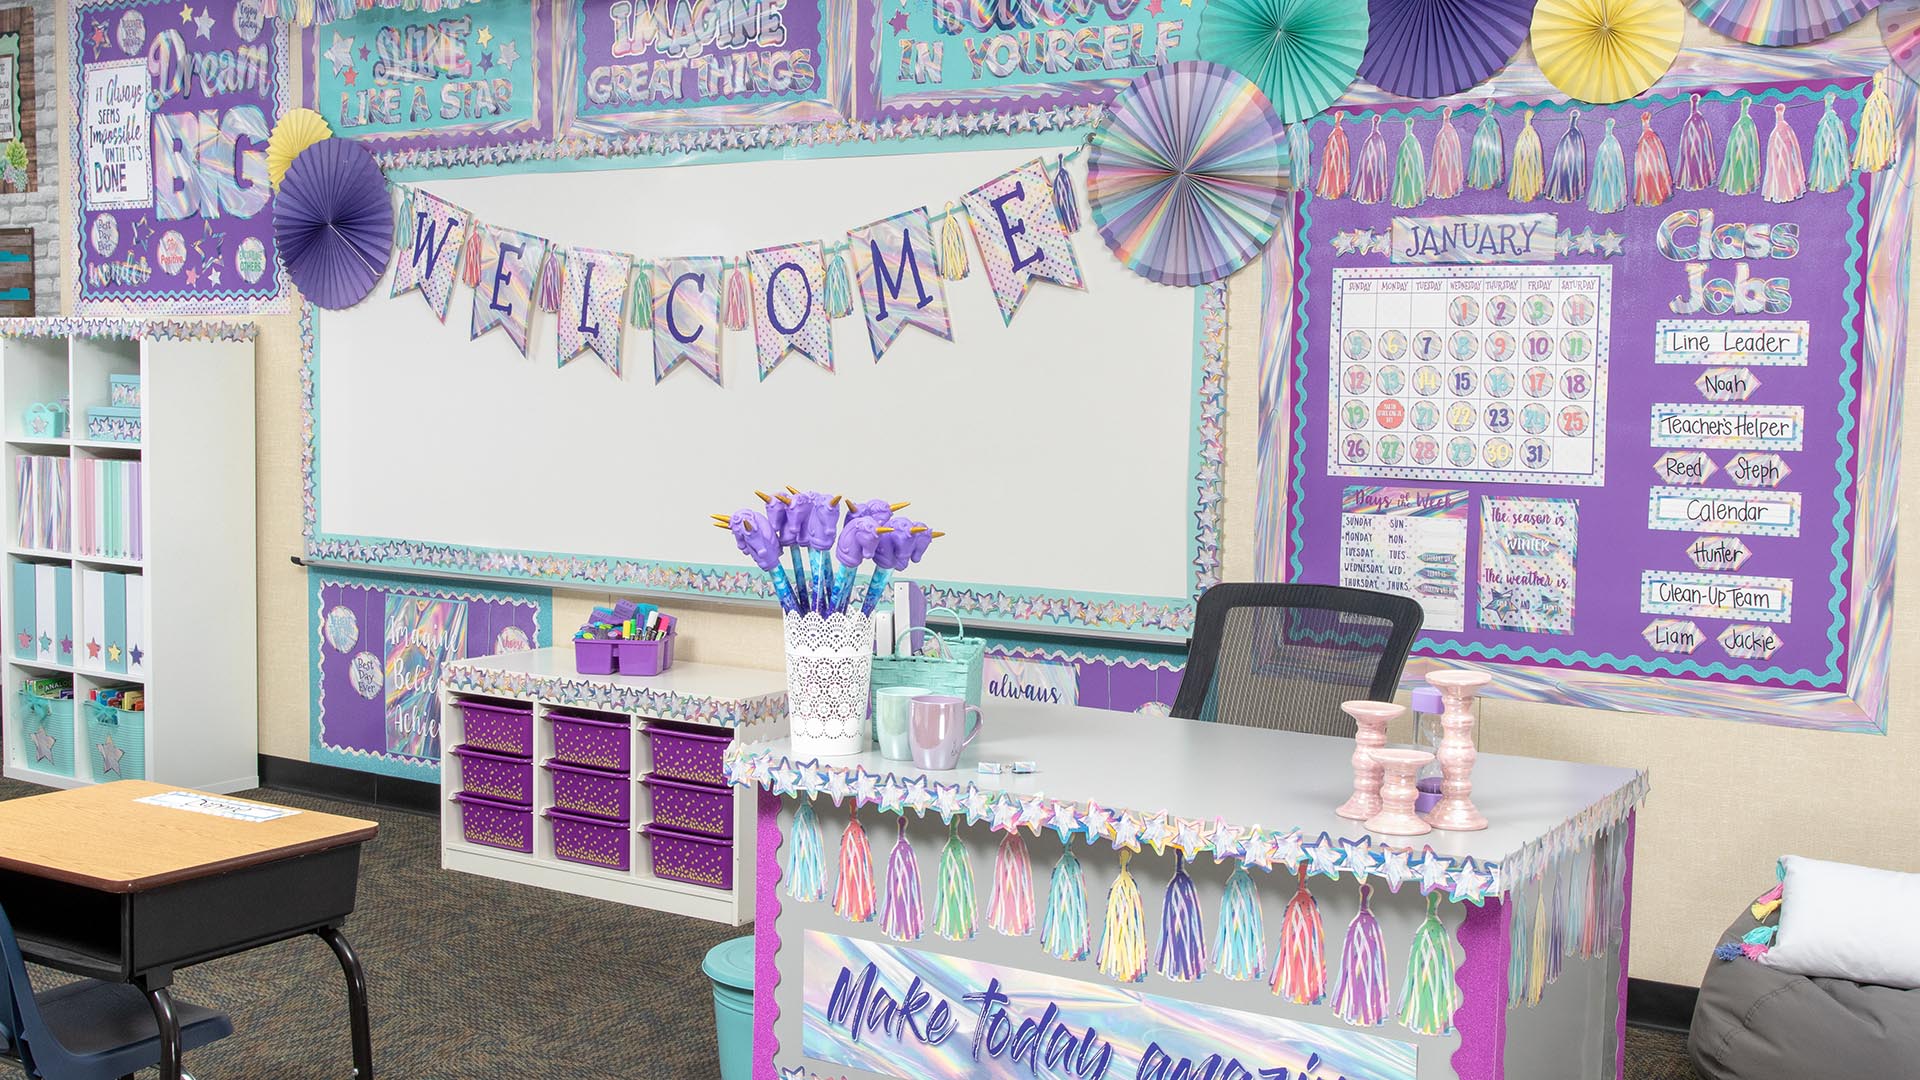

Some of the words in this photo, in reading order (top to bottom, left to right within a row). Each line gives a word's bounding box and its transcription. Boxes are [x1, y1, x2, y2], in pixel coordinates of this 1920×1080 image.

[610, 0, 787, 58] IMAGINE
[373, 14, 473, 86] SHINE
[896, 39, 944, 84] IN
[963, 19, 1185, 81] YOURSELF
[145, 29, 272, 112] Dream
[583, 57, 691, 105] GREAT
[690, 48, 814, 97] THINGS
[340, 88, 401, 127] LIKE
[409, 86, 432, 123] A
[440, 78, 513, 120] STAR
[98, 108, 120, 124] SEEMS
[89, 114, 142, 153] Impossible
[105, 146, 125, 163] UNTIL
[128, 146, 143, 161] IT'S
[154, 105, 272, 220] BIG
[94, 162, 128, 193] DONE
[1405, 221, 1541, 257] JANUARY
[1656, 208, 1800, 261] Class
[412, 181, 1045, 344] WELCOME
[1349, 282, 1372, 291] SUNDAY
[1381, 281, 1408, 291] MONDAY
[1416, 281, 1443, 291] TUESDAY
[1450, 280, 1482, 291] WEDNESDAY
[1486, 280, 1518, 290] THURSDAY
[1528, 280, 1552, 290] FRIDAY
[1561, 280, 1596, 290] SATURDAY
[1669, 263, 1792, 315] Jobs
[1461, 303, 1467, 320] 1
[1496, 301, 1506, 320] 2
[1532, 301, 1544, 319] 3
[1388, 335, 1398, 354] 6
[1422, 336, 1432, 354] 7
[1457, 336, 1469, 355] 8
[1495, 337, 1506, 355] 9
[1529, 337, 1549, 355] 10
[1570, 337, 1583, 356] 11
[1673, 332, 1710, 352] Line
[1724, 332, 1790, 352] Leader
[1350, 371, 1365, 390] 12
[1382, 371, 1399, 390] 13
[1419, 370, 1436, 390] 14
[1455, 372, 1471, 390] 15
[1529, 373, 1545, 392] 17
[1566, 374, 1586, 394] 18
[1705, 374, 1747, 394] Noah
[1347, 405, 1364, 424] 19
[1416, 406, 1433, 425] 21
[1452, 406, 1471, 425] 22
[1489, 408, 1509, 427] 23
[1562, 411, 1584, 431] 25
[1661, 415, 1732, 435] Teacher's
[1734, 415, 1789, 439] Helper
[1347, 440, 1365, 457] 26
[1381, 441, 1399, 459] 27
[1415, 441, 1435, 460] 28
[1487, 444, 1508, 463] 30
[1526, 445, 1542, 462] 31
[1666, 457, 1702, 477] Reed
[1735, 457, 1779, 483] Steph
[1355, 490, 1392, 512] Days
[1397, 499, 1412, 508] the
[1416, 491, 1455, 509] Week
[1687, 499, 1768, 522] Calendar
[1346, 517, 1372, 527] SUNDAY
[1390, 519, 1408, 529] SUN.
[1491, 507, 1509, 523] The
[1512, 512, 1552, 525] season
[1555, 512, 1566, 527] is
[1345, 531, 1373, 542] MONDAY
[1388, 534, 1407, 544] MON.
[1505, 534, 1550, 552] WINTER
[1345, 547, 1374, 558] TUESDAY
[1389, 550, 1409, 560] TUES.
[1693, 541, 1743, 563] Hunter
[1344, 562, 1383, 574] WEDNESDAY
[1388, 565, 1406, 575] WED.
[1485, 568, 1503, 584] The
[1506, 570, 1553, 587] weather
[1557, 573, 1569, 589] is
[1344, 577, 1378, 589] THURSDAY
[1659, 582, 1726, 608] Clean-Up
[1727, 588, 1770, 609] Team
[391, 615, 459, 660] Imagine
[1656, 626, 1694, 646] Liam
[1724, 629, 1776, 652] Jackie
[358, 658, 374, 671] Best
[394, 657, 441, 694] Belie
[358, 670, 374, 684] Day
[358, 682, 375, 693] Ever
[394, 704, 441, 738] Achie
[827, 961, 959, 1045] Make
[962, 977, 1114, 1080] today
